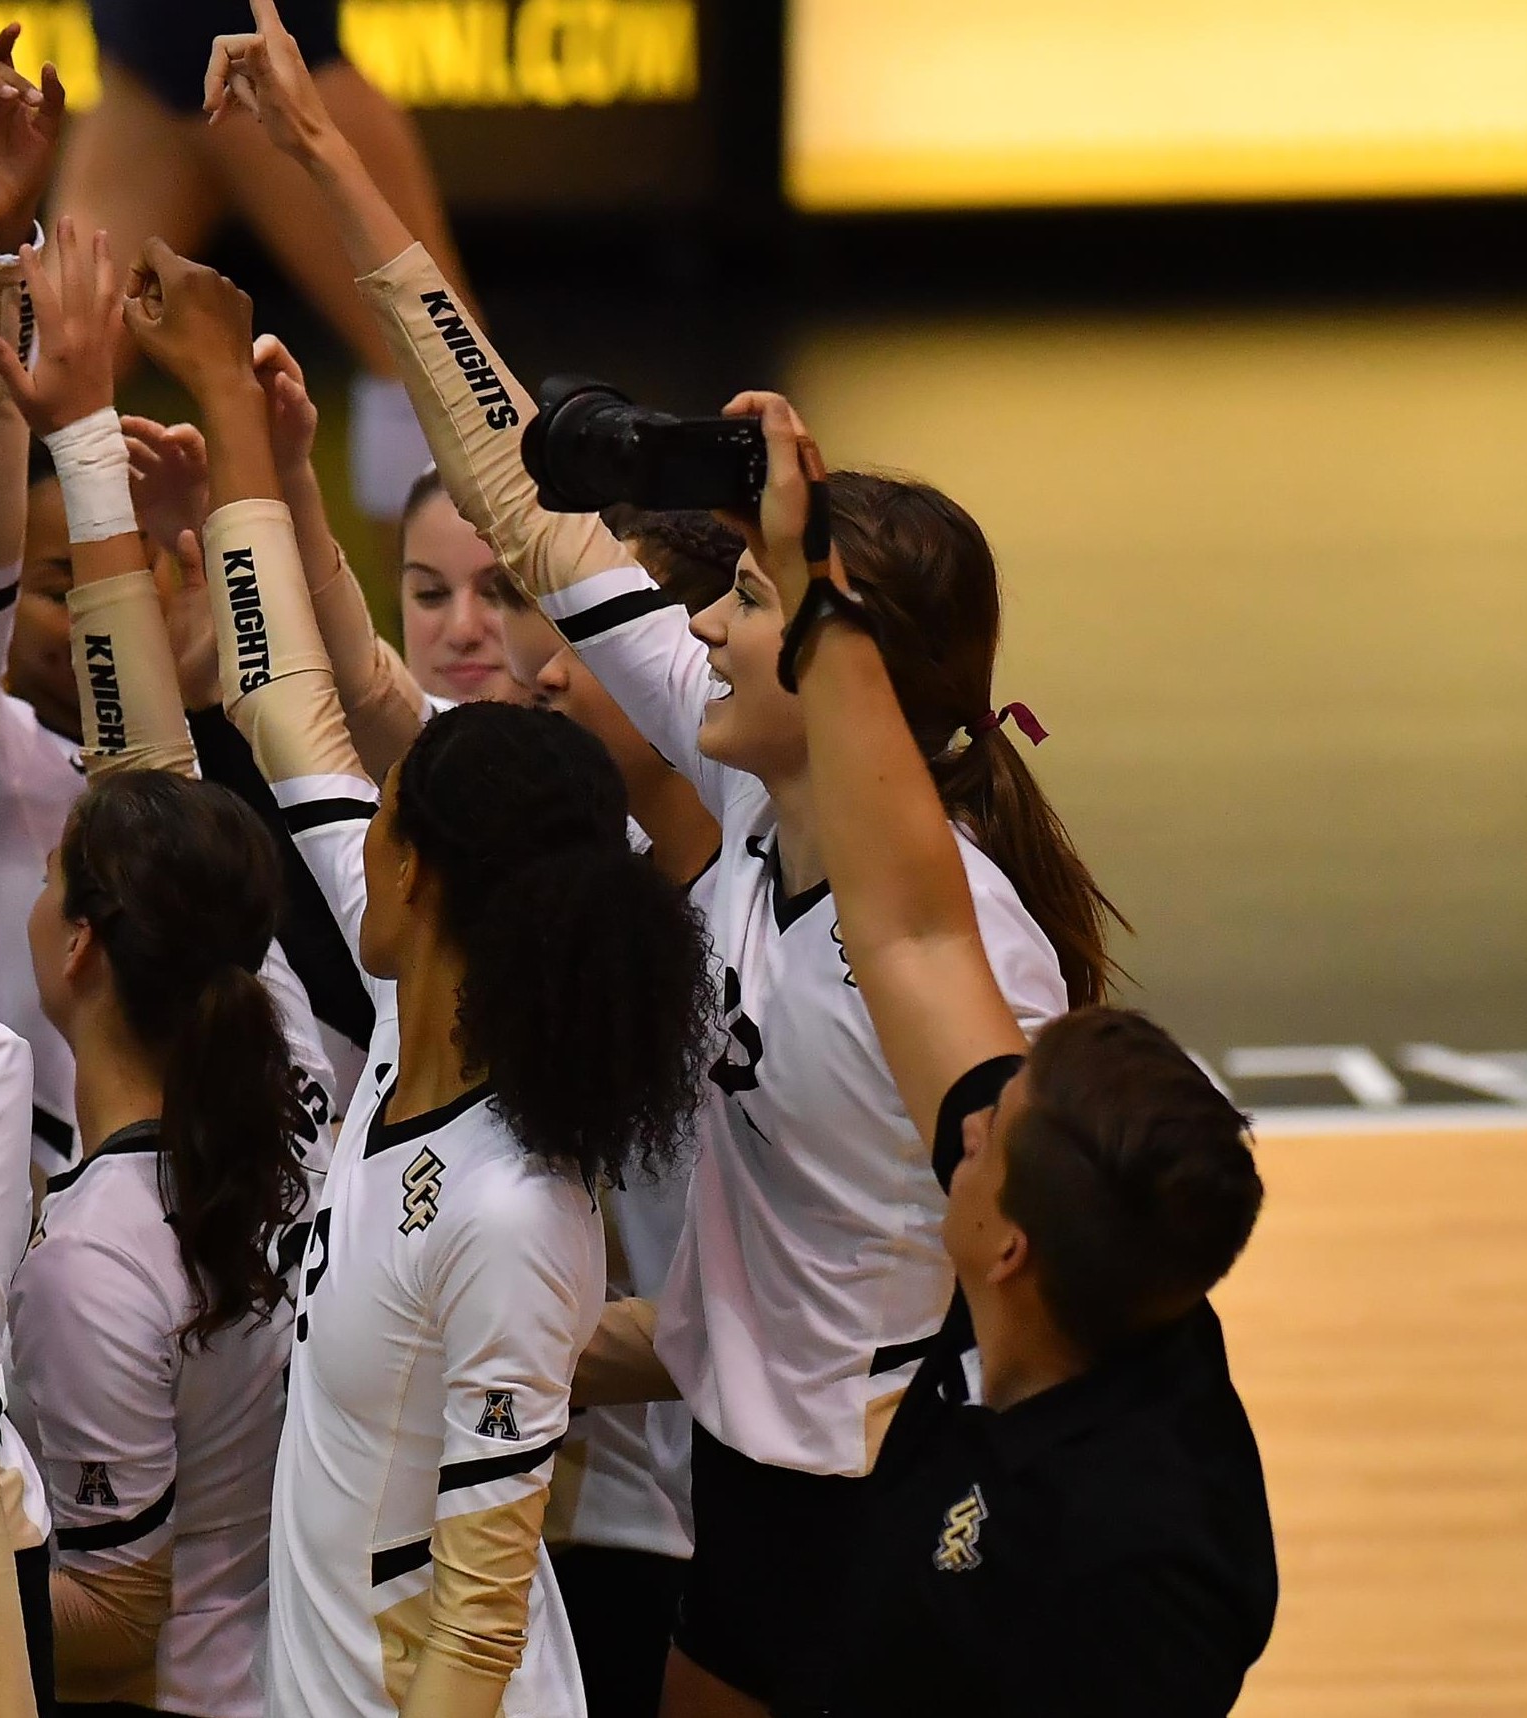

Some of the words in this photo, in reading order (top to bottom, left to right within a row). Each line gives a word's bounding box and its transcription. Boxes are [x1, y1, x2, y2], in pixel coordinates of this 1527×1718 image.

[420, 289, 520, 431] KNIGHTS
[222, 546, 272, 694] KNIGHTS
[84, 633, 128, 757] KNIGH
